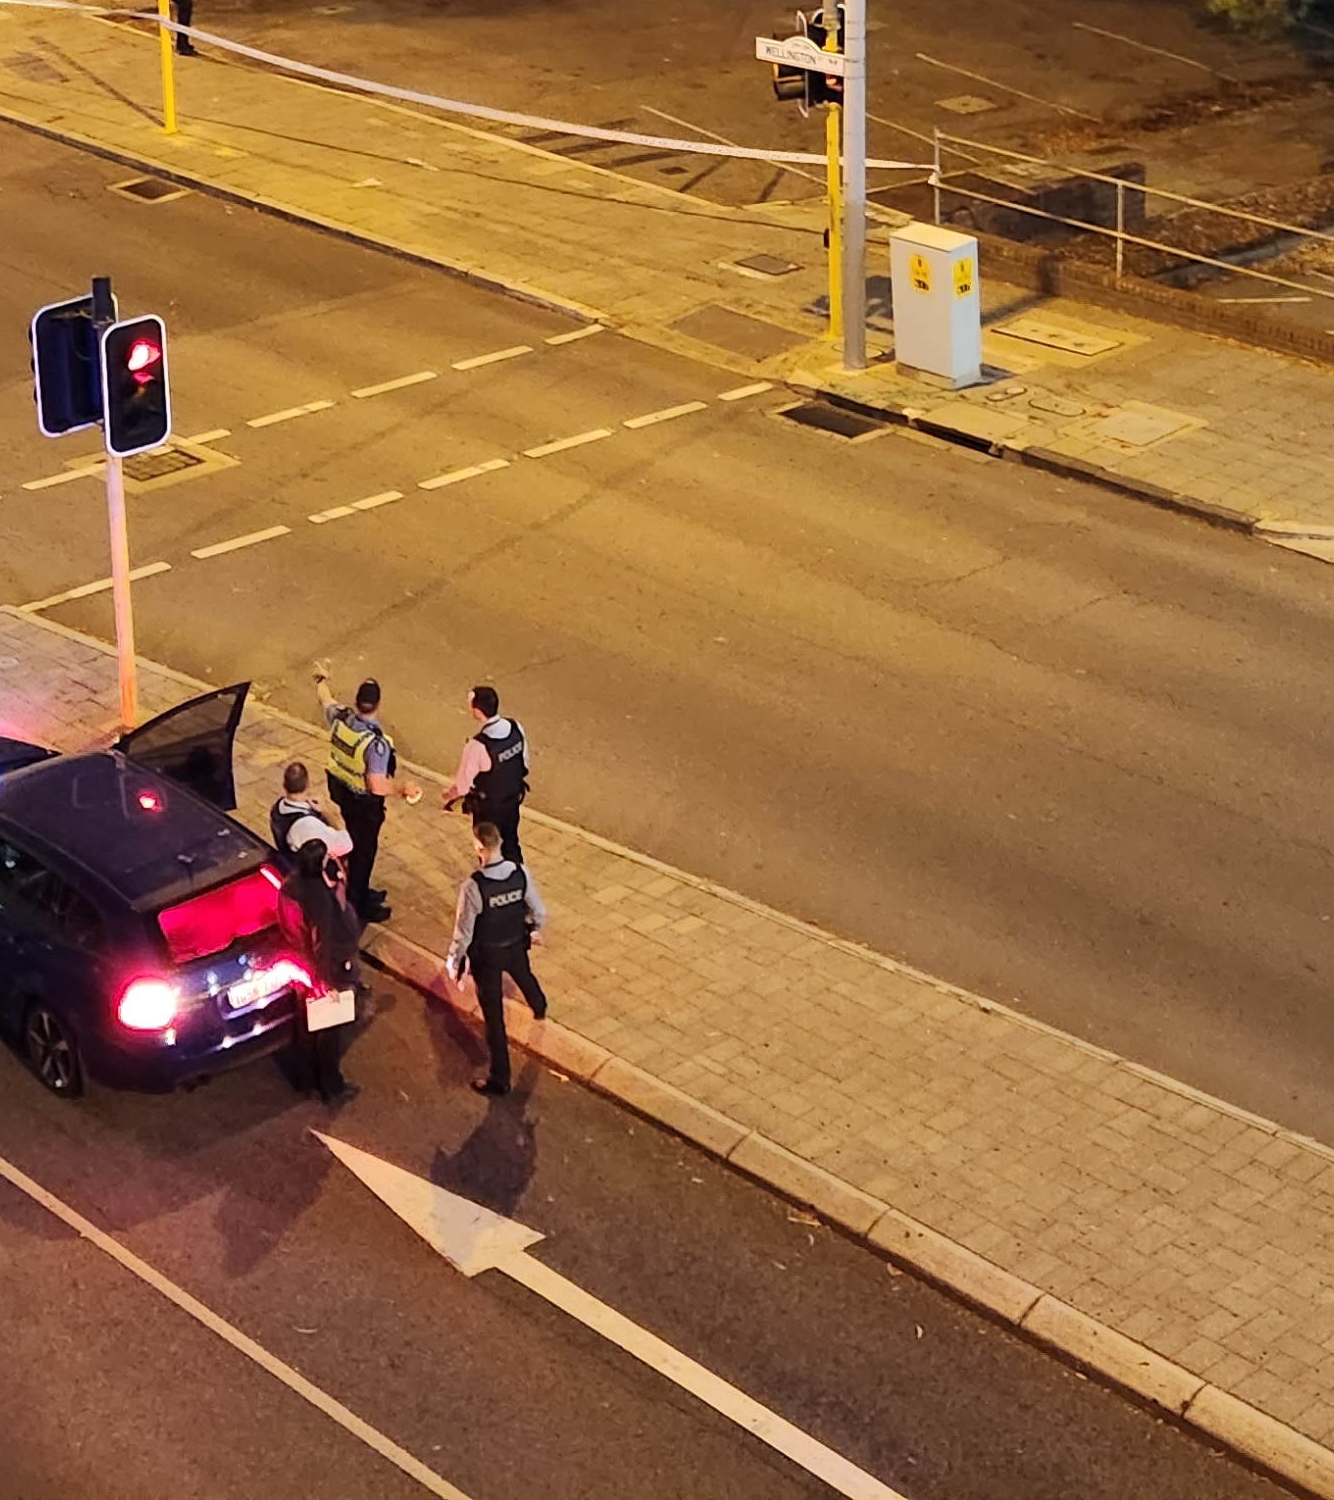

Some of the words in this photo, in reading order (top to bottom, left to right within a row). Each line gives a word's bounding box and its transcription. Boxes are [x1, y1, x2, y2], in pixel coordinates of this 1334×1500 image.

[765, 46, 817, 66] WELLINGTON
[497, 741, 523, 763] POLICE
[488, 889, 523, 908] POLICE
